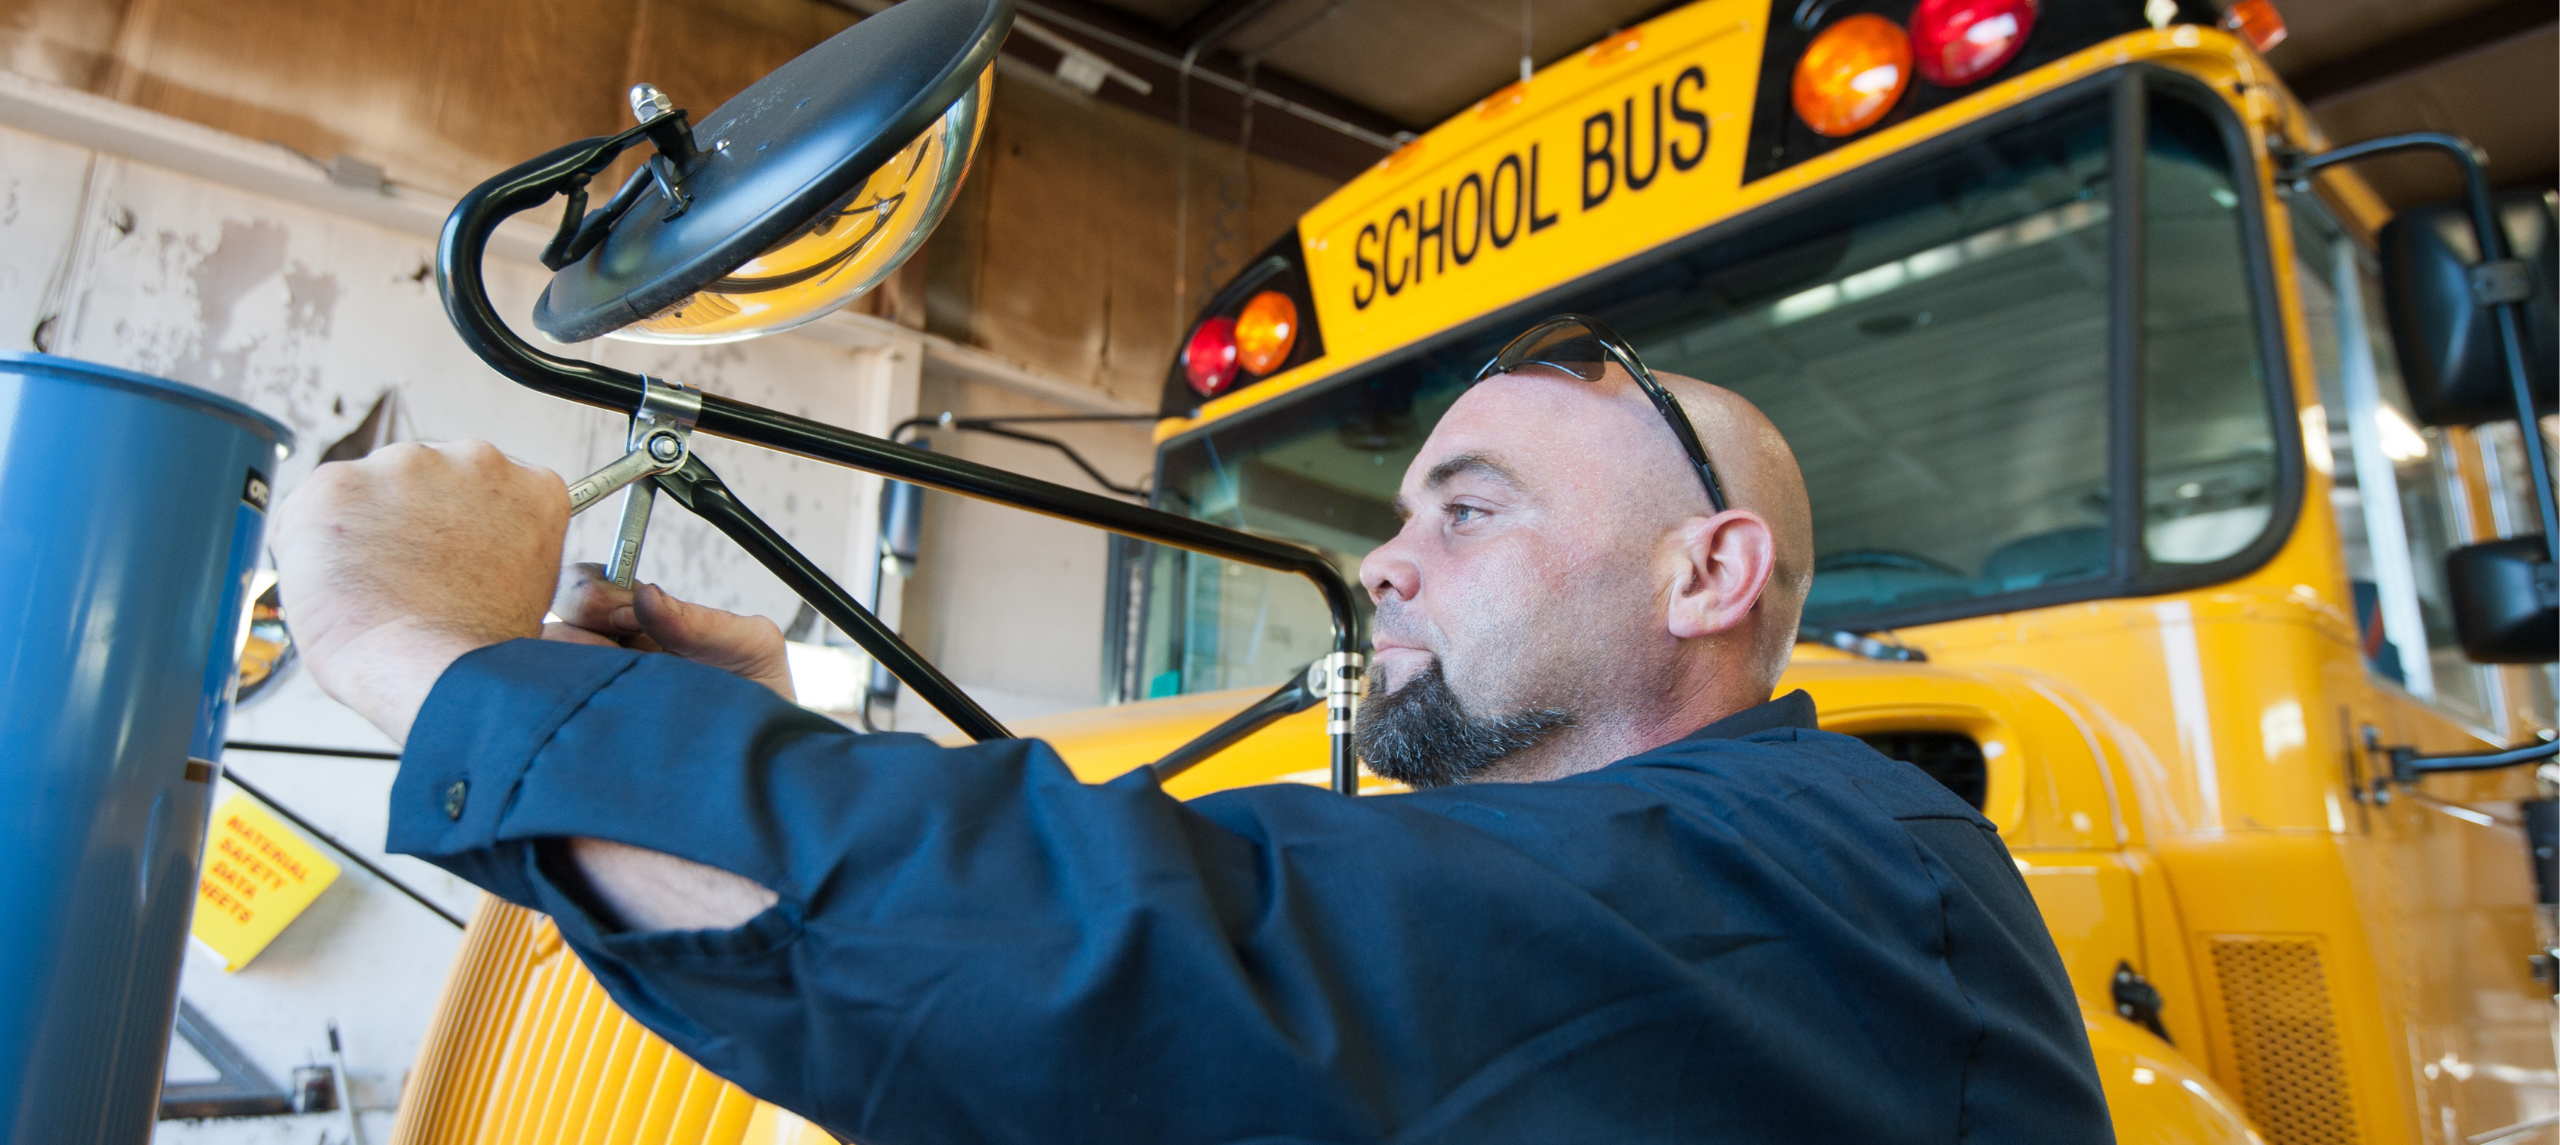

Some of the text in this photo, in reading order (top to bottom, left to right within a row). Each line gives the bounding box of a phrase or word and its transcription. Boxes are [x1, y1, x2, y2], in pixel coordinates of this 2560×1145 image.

[1353, 65, 1711, 311] SCHOOL BUS
[621, 550, 633, 567] 1/2
[220, 839, 285, 887] SAFETY
[228, 816, 308, 881] MATERIAL
[201, 878, 252, 922] HEETS
[213, 862, 256, 898] DATA
